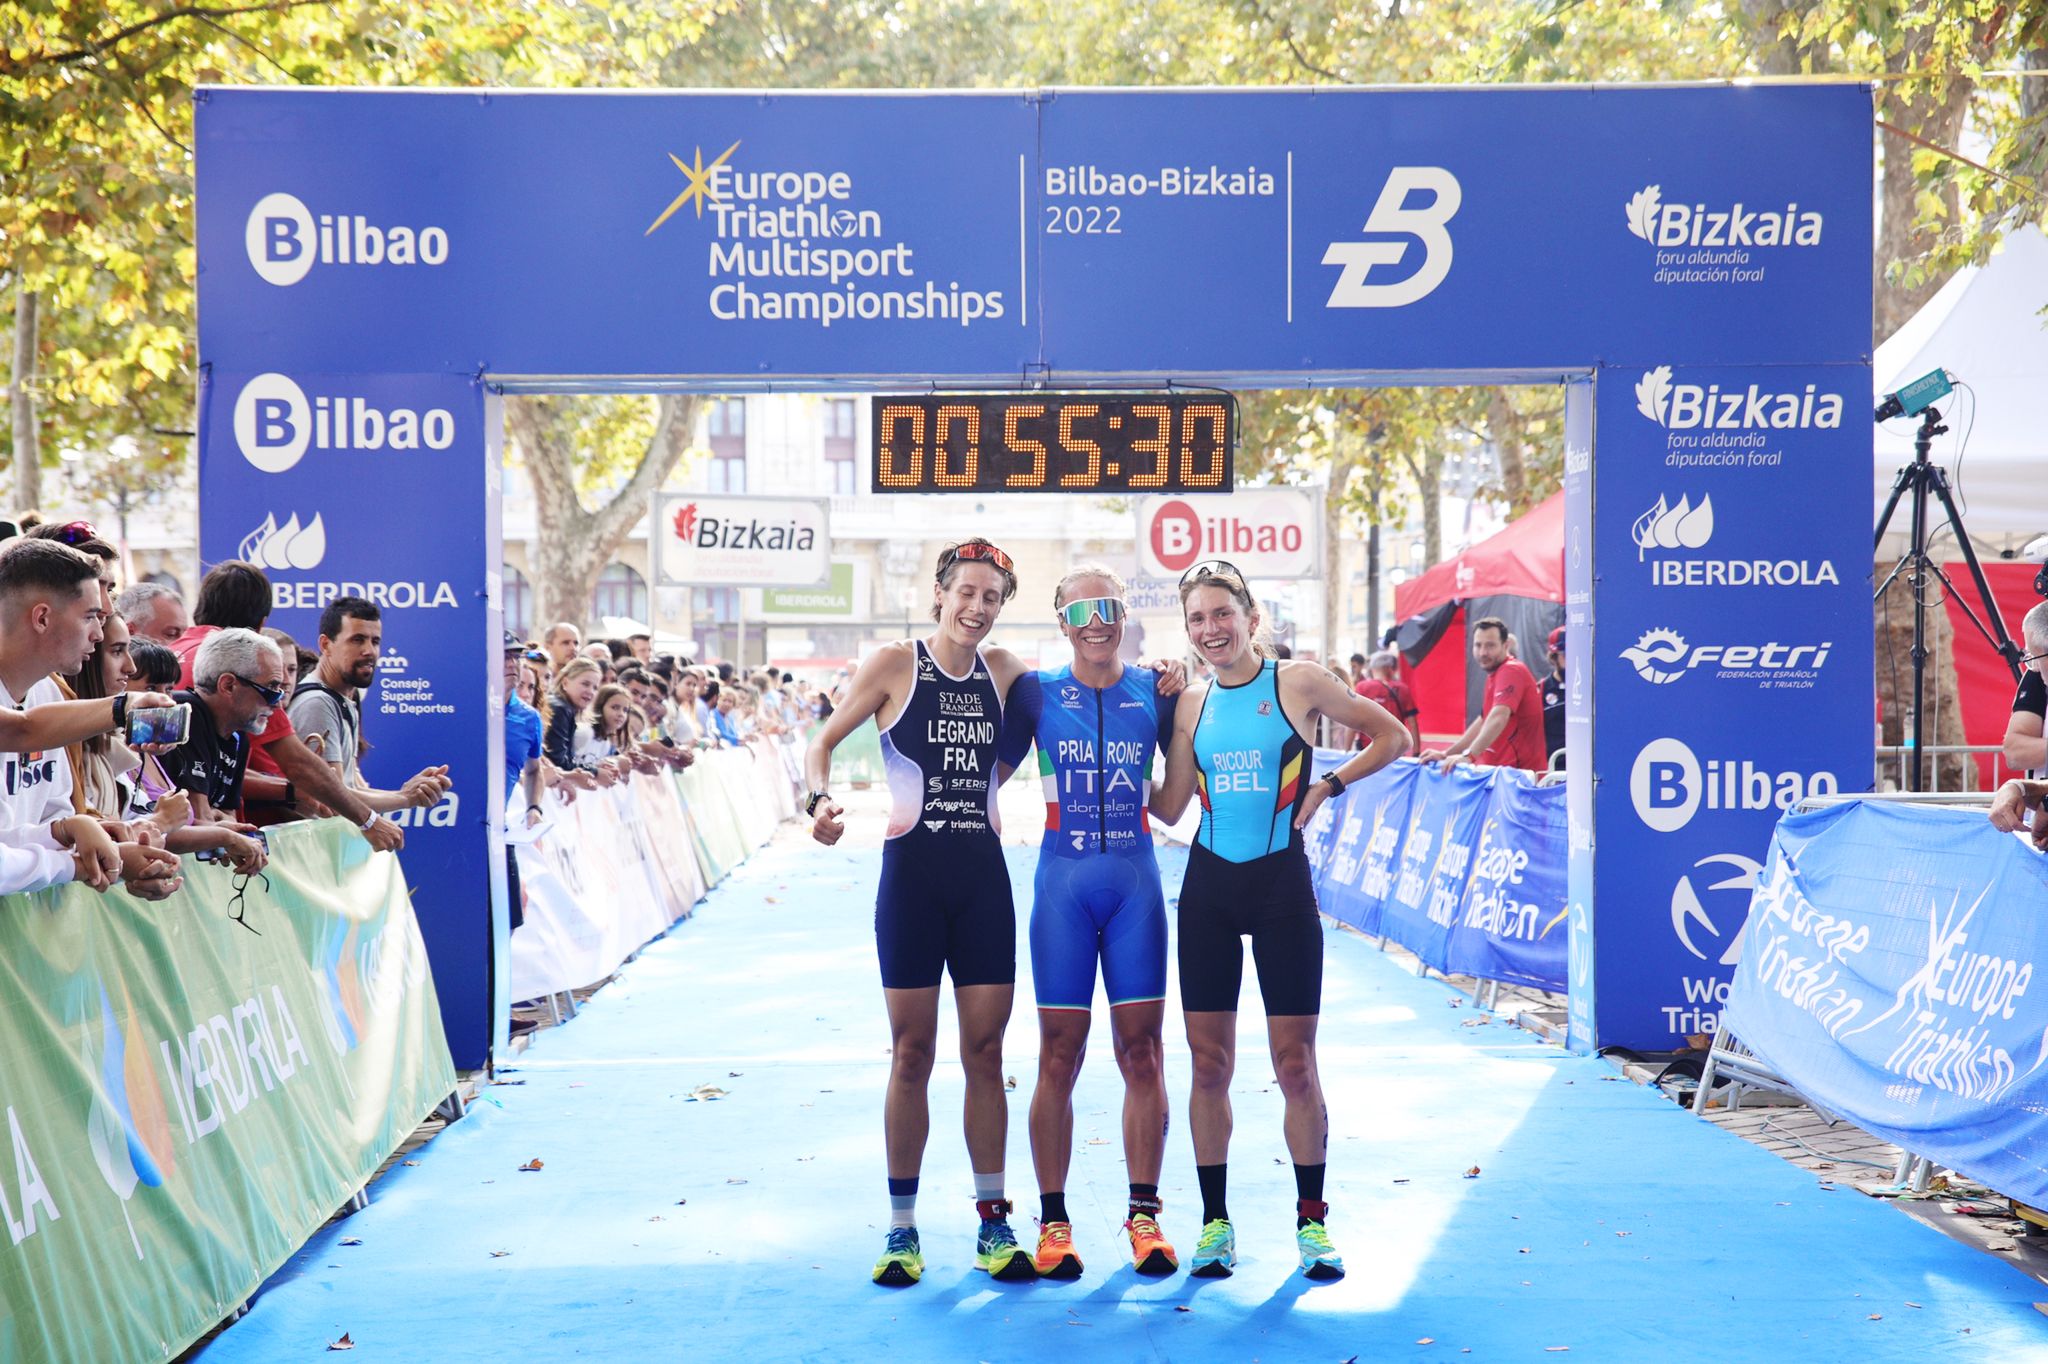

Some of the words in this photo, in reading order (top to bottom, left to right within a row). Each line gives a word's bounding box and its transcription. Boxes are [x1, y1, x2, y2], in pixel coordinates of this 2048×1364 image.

[709, 166, 851, 202] Europe
[1046, 165, 1274, 196] Bilbao-Bizkaia
[709, 203, 881, 239] Triathlon
[1046, 206, 1122, 234] 2022
[1656, 203, 1823, 247] Bizkaia
[264, 215, 449, 265] Bilbao
[709, 240, 914, 282] Multisport
[1655, 249, 1685, 267] foru
[1687, 249, 1750, 265] aldundia
[1654, 266, 1729, 285] diputación
[1731, 266, 1765, 285] foral
[709, 284, 1004, 328] Championships
[1669, 384, 1843, 430] Bizkaia
[254, 396, 455, 450] Bilbao
[879, 405, 981, 487] 00
[1004, 405, 1227, 487] 55:30
[1666, 432, 1698, 450] foru
[1700, 432, 1766, 448] aldundia
[1665, 450, 1745, 469] diputación
[1747, 450, 1782, 469] foral
[698, 517, 815, 551] Bizkaia
[1161, 517, 1303, 556] Bilbao
[1652, 560, 1839, 586] IBERDROLA
[271, 582, 459, 609] BERDROLA
[381, 677, 431, 691] Consejo
[381, 690, 434, 704] Superior
[380, 702, 396, 714] de
[399, 702, 455, 716] Deportes
[939, 691, 982, 705] STADE
[927, 719, 994, 745] LEGRAND
[943, 746, 980, 773] FRA
[1212, 749, 1264, 773] RICOUR
[950, 778, 988, 790] SFERIS
[1065, 768, 1137, 794] ITA
[1214, 771, 1270, 794] BEL
[950, 820, 986, 830] triathlon
[1926, 931, 2034, 1026] Europe
